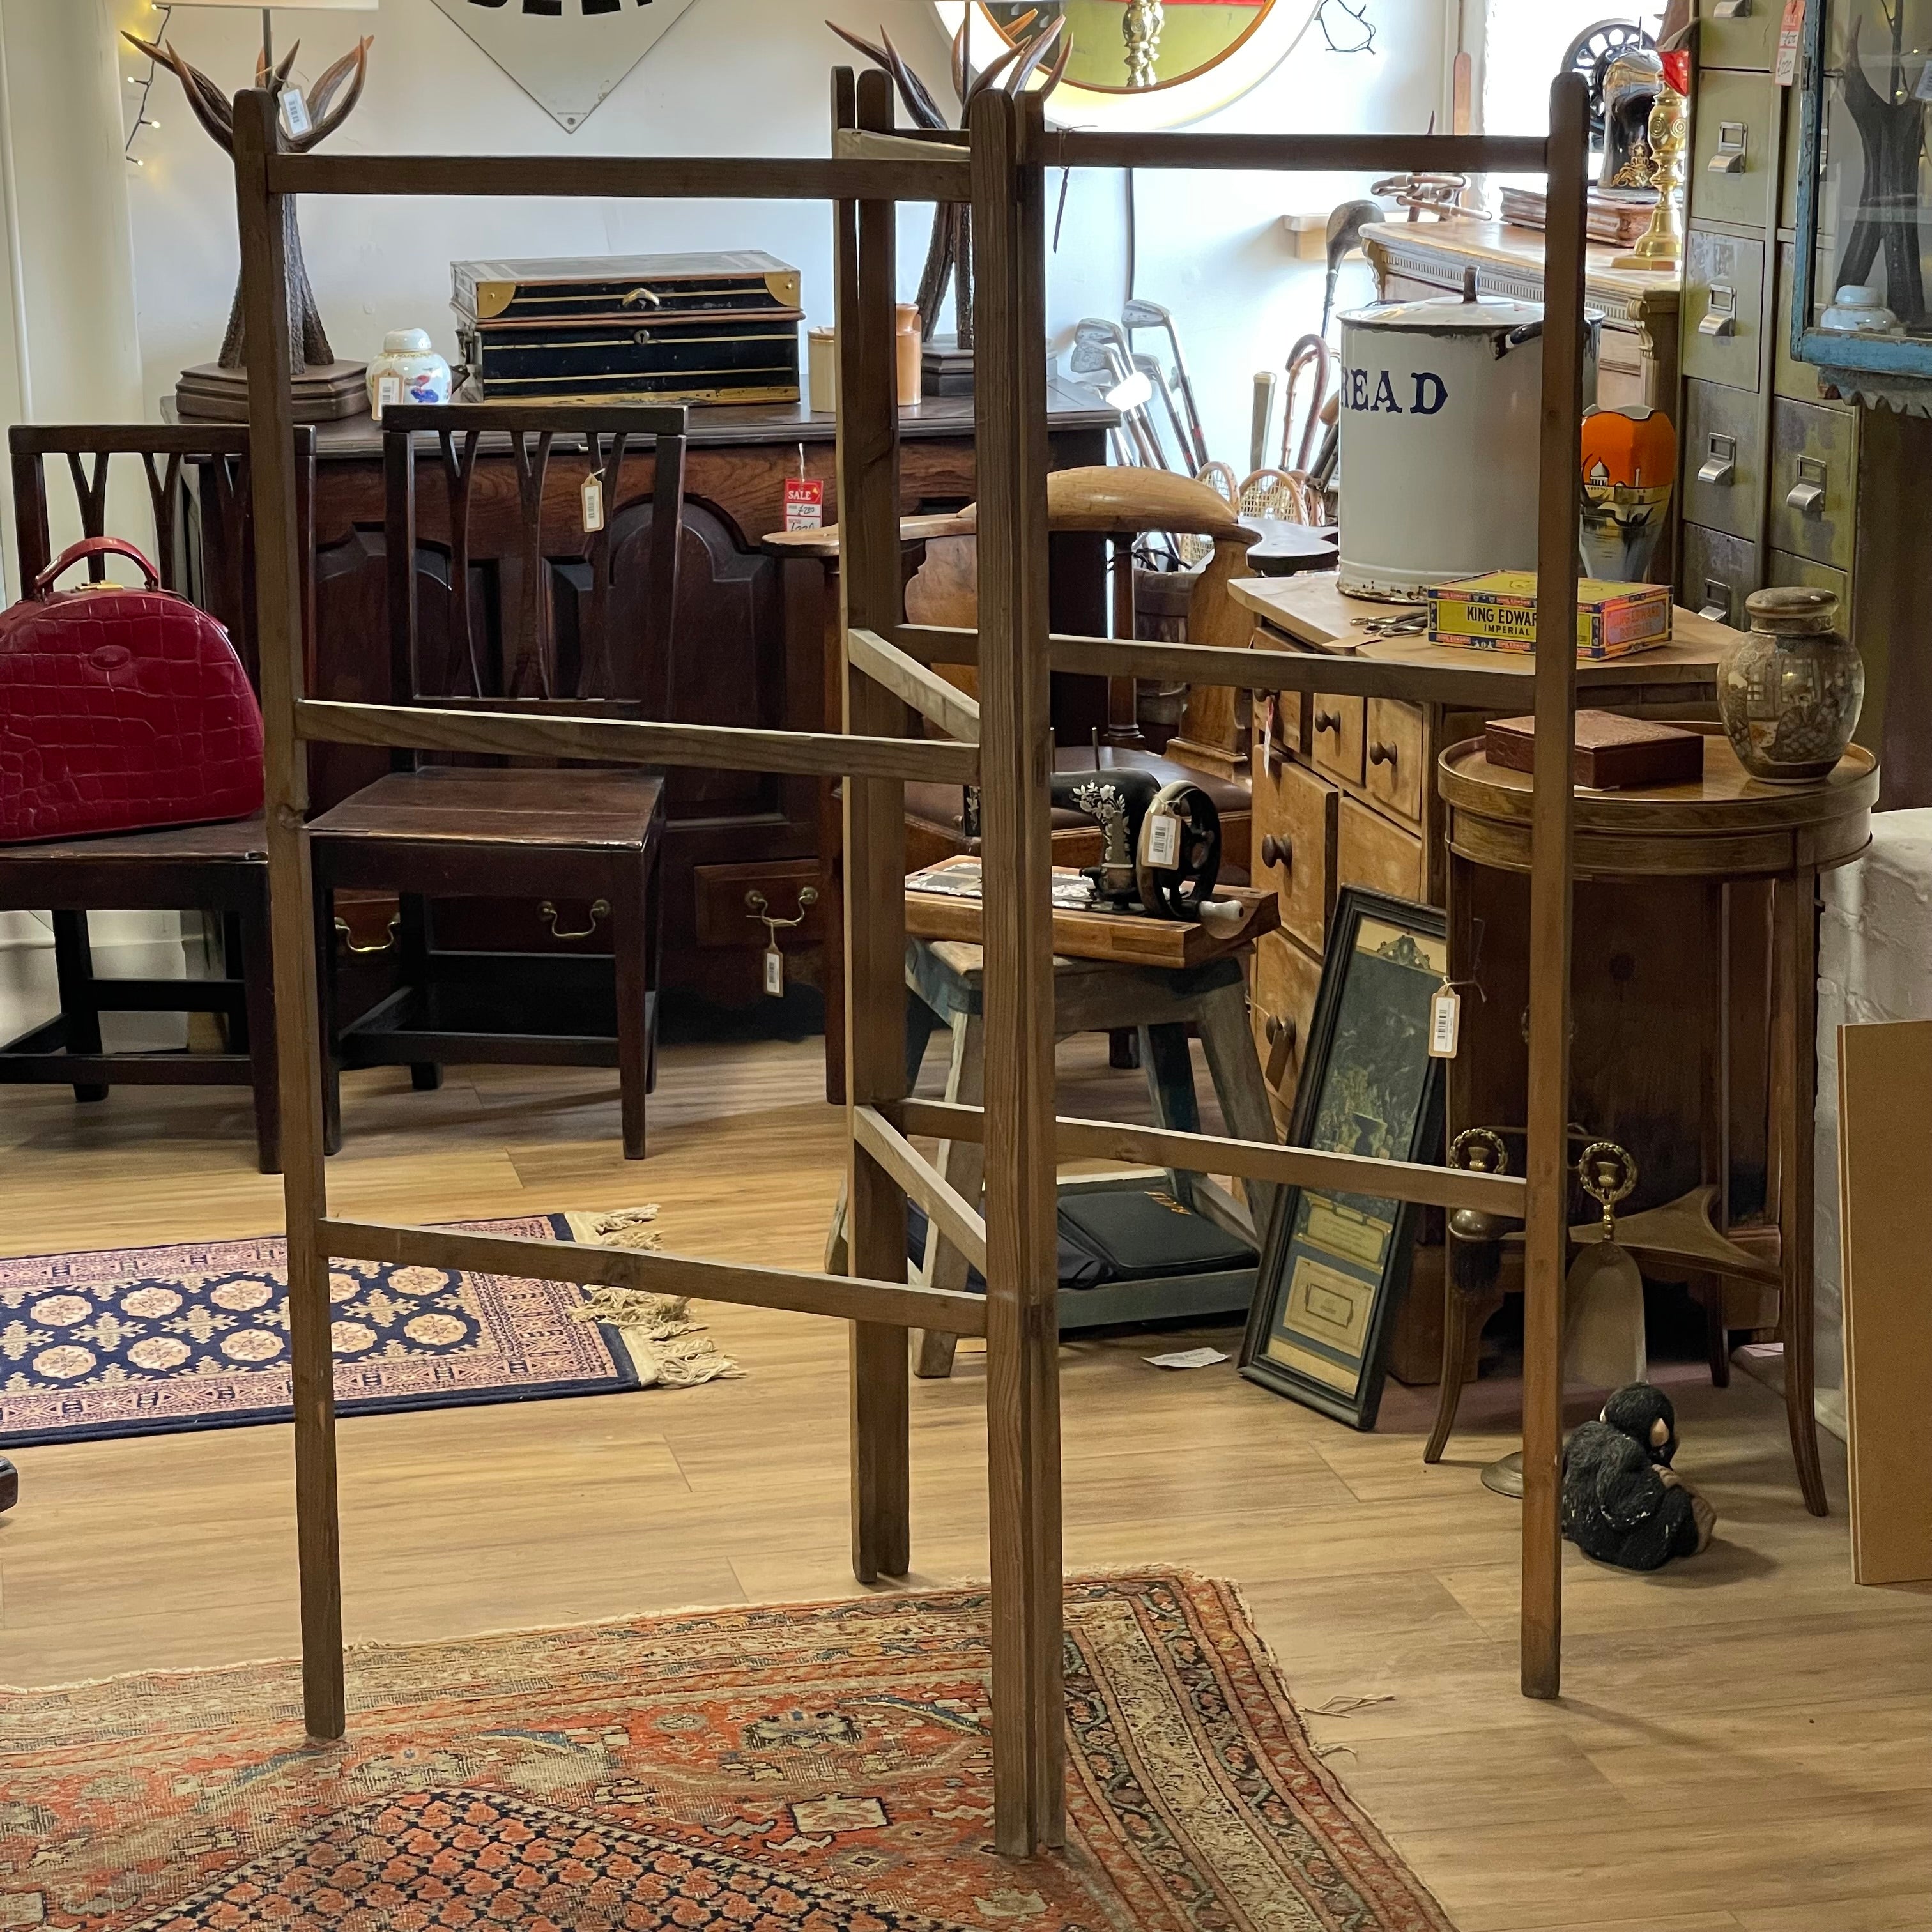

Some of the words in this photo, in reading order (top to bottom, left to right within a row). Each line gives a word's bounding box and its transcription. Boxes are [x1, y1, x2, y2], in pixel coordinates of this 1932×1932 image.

[788, 490, 811, 500] SALE
[1467, 606, 1494, 622] KING
[1498, 609, 1537, 627] EDWAR
[1484, 624, 1530, 636] IMPERIAL
